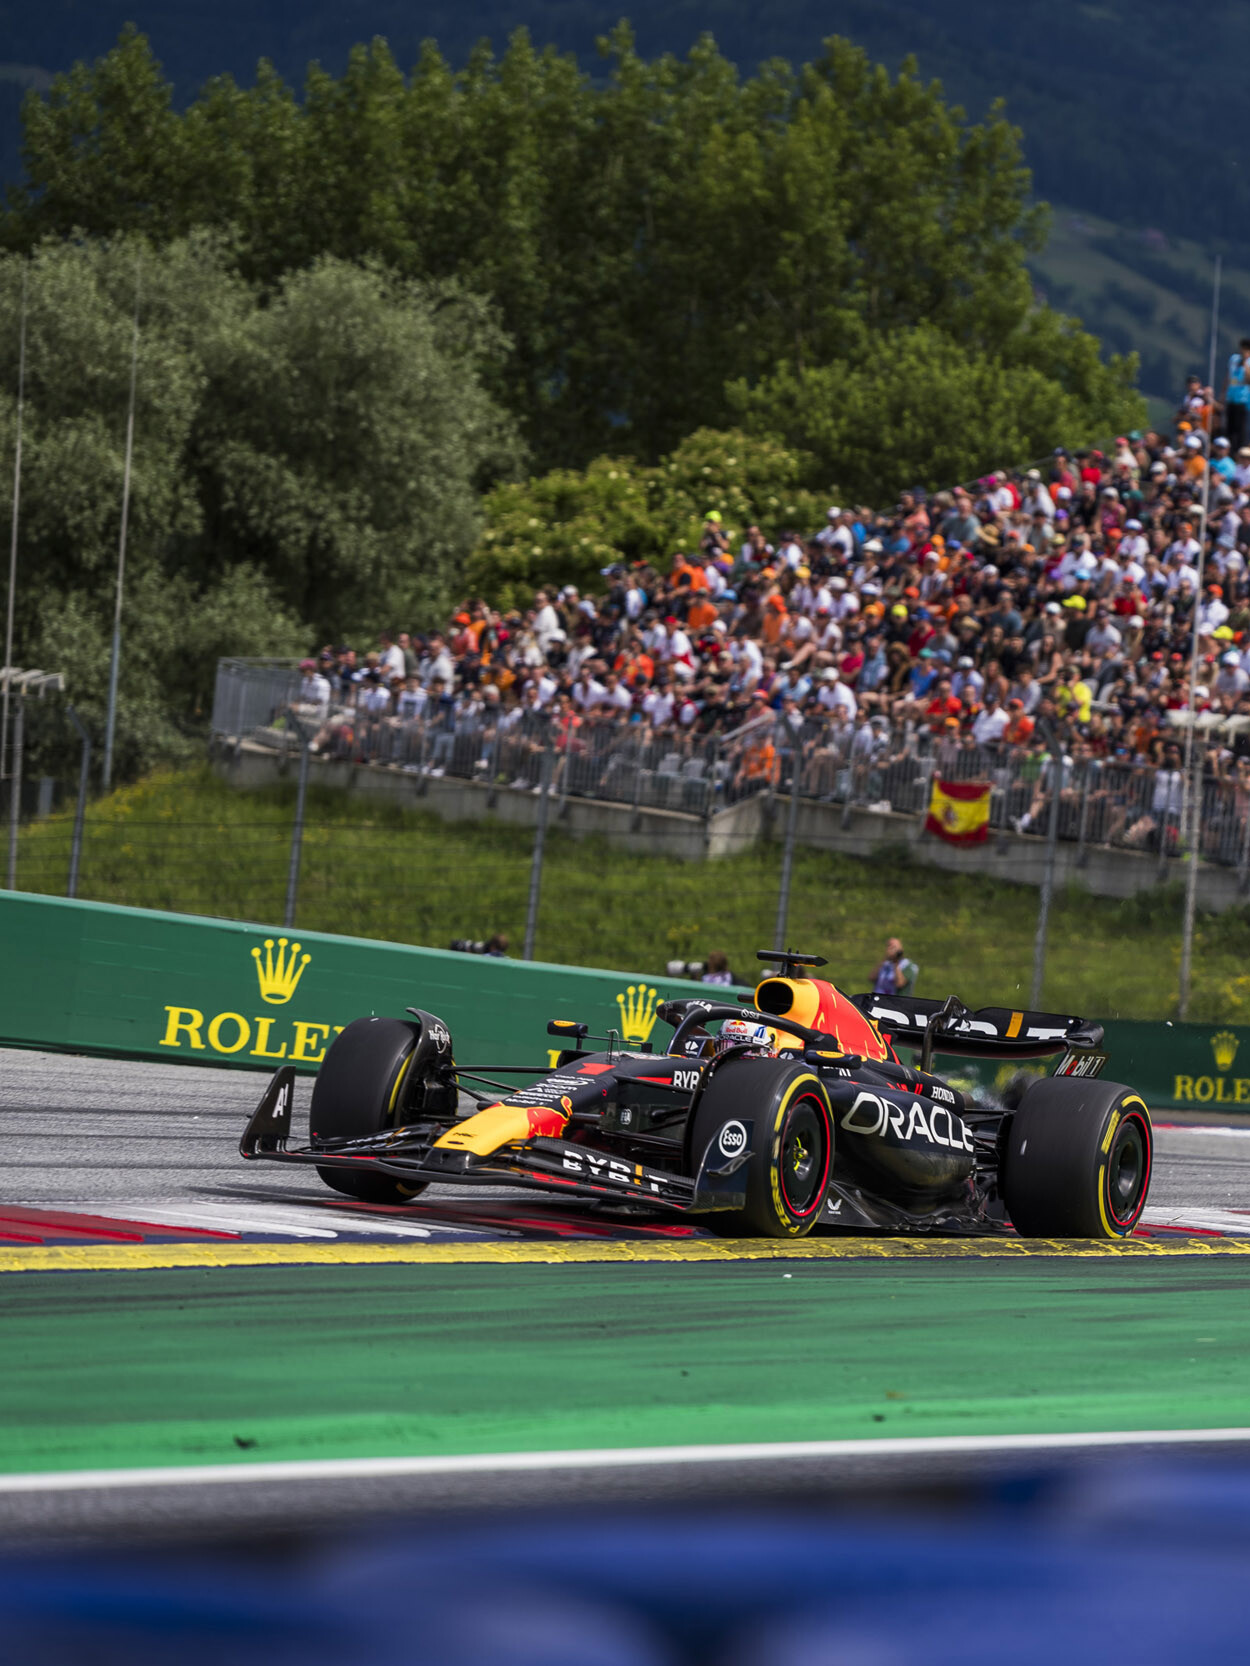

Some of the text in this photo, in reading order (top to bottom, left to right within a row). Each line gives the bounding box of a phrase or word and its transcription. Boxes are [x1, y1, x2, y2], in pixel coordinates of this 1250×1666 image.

[159, 1005, 345, 1063] ROLE
[1055, 1054, 1095, 1077] Mobil
[673, 1069, 704, 1090] BYB
[931, 1086, 956, 1105] HONDA
[841, 1091, 974, 1153] ORACLE
[722, 1129, 742, 1146] Esso
